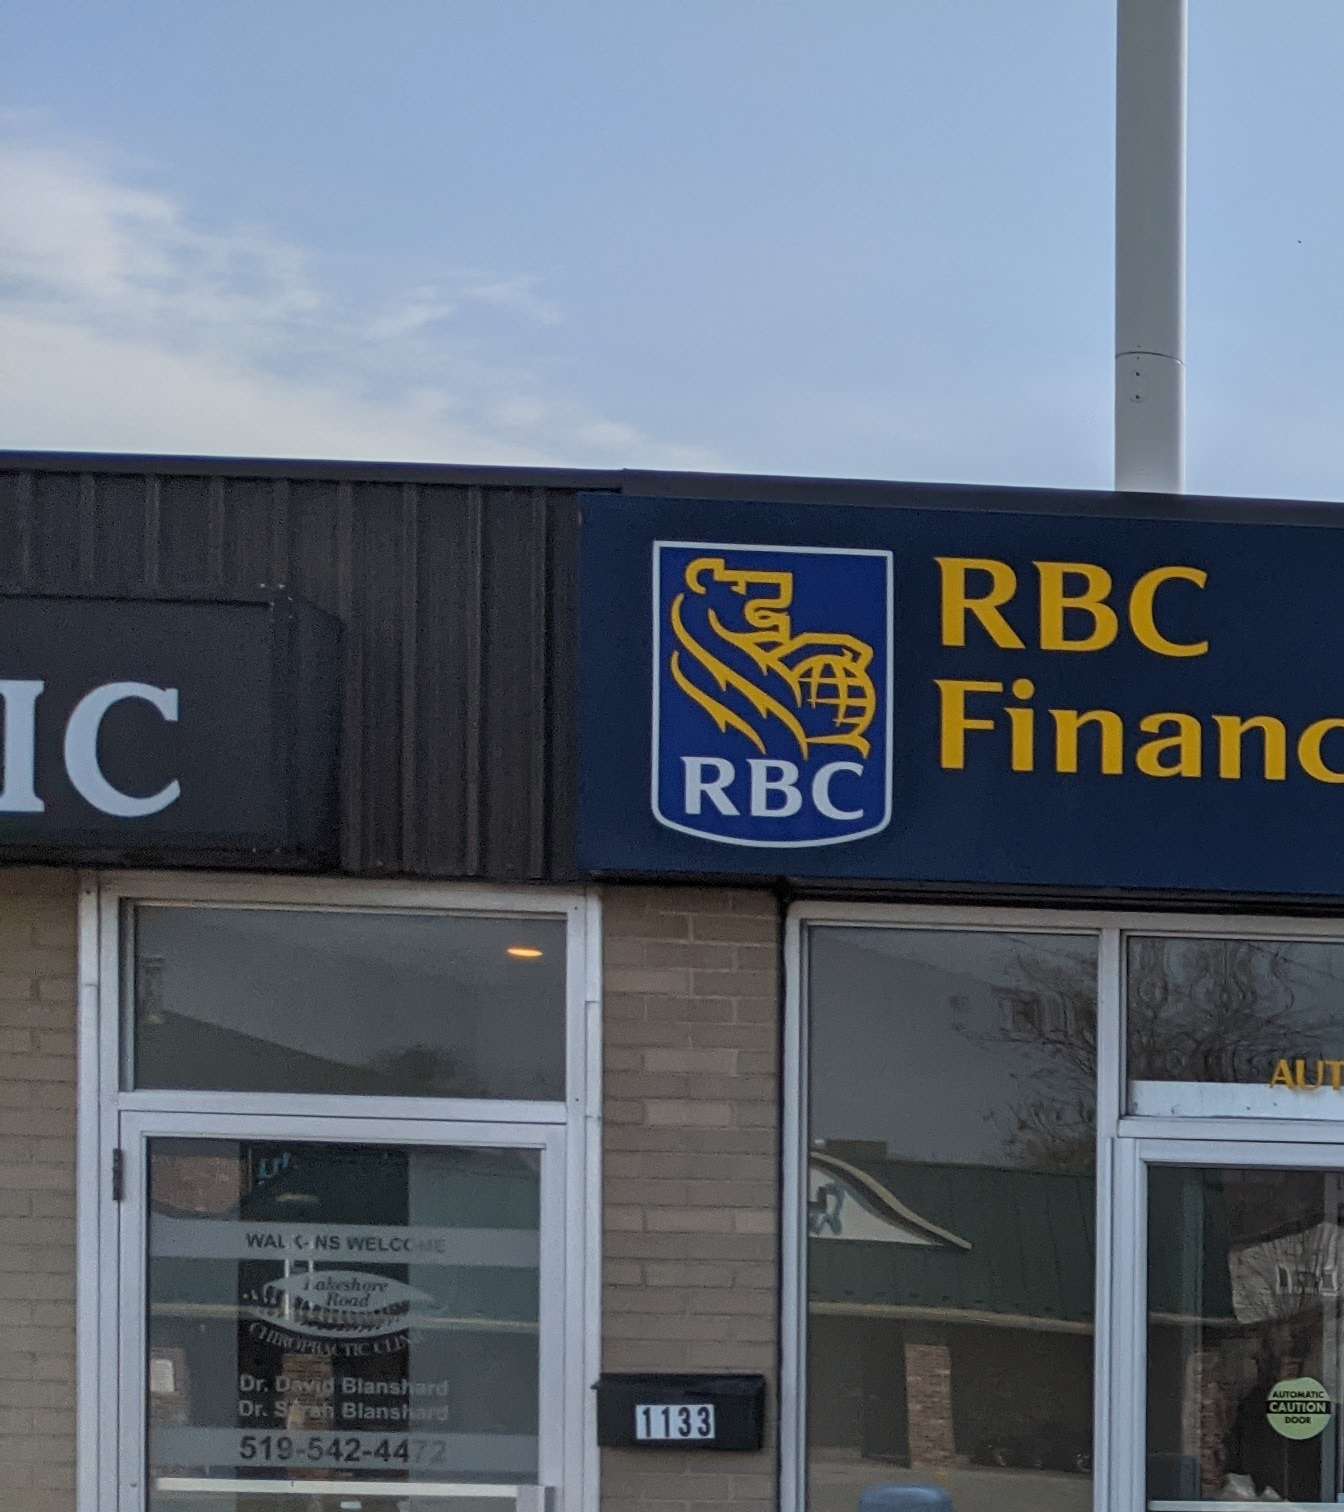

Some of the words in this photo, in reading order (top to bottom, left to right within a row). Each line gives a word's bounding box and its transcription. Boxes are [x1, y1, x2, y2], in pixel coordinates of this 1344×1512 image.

[933, 556, 1209, 657] RBC
[680, 755, 867, 822] RBC
[303, 1276, 389, 1293] Lakeshore
[326, 1292, 371, 1307] Road
[239, 1375, 269, 1392] Dr.
[275, 1376, 335, 1394] David
[342, 1377, 449, 1396] Blanshard
[1273, 1390, 1324, 1399] AUTOMATIC
[238, 1400, 268, 1417] Dr.
[342, 1402, 449, 1421] Blanshard
[1269, 1401, 1327, 1412] CAUTION
[642, 1405, 711, 1437] 1133
[1285, 1416, 1312, 1424] DOOR
[239, 1435, 448, 1464] 519-542-4472
